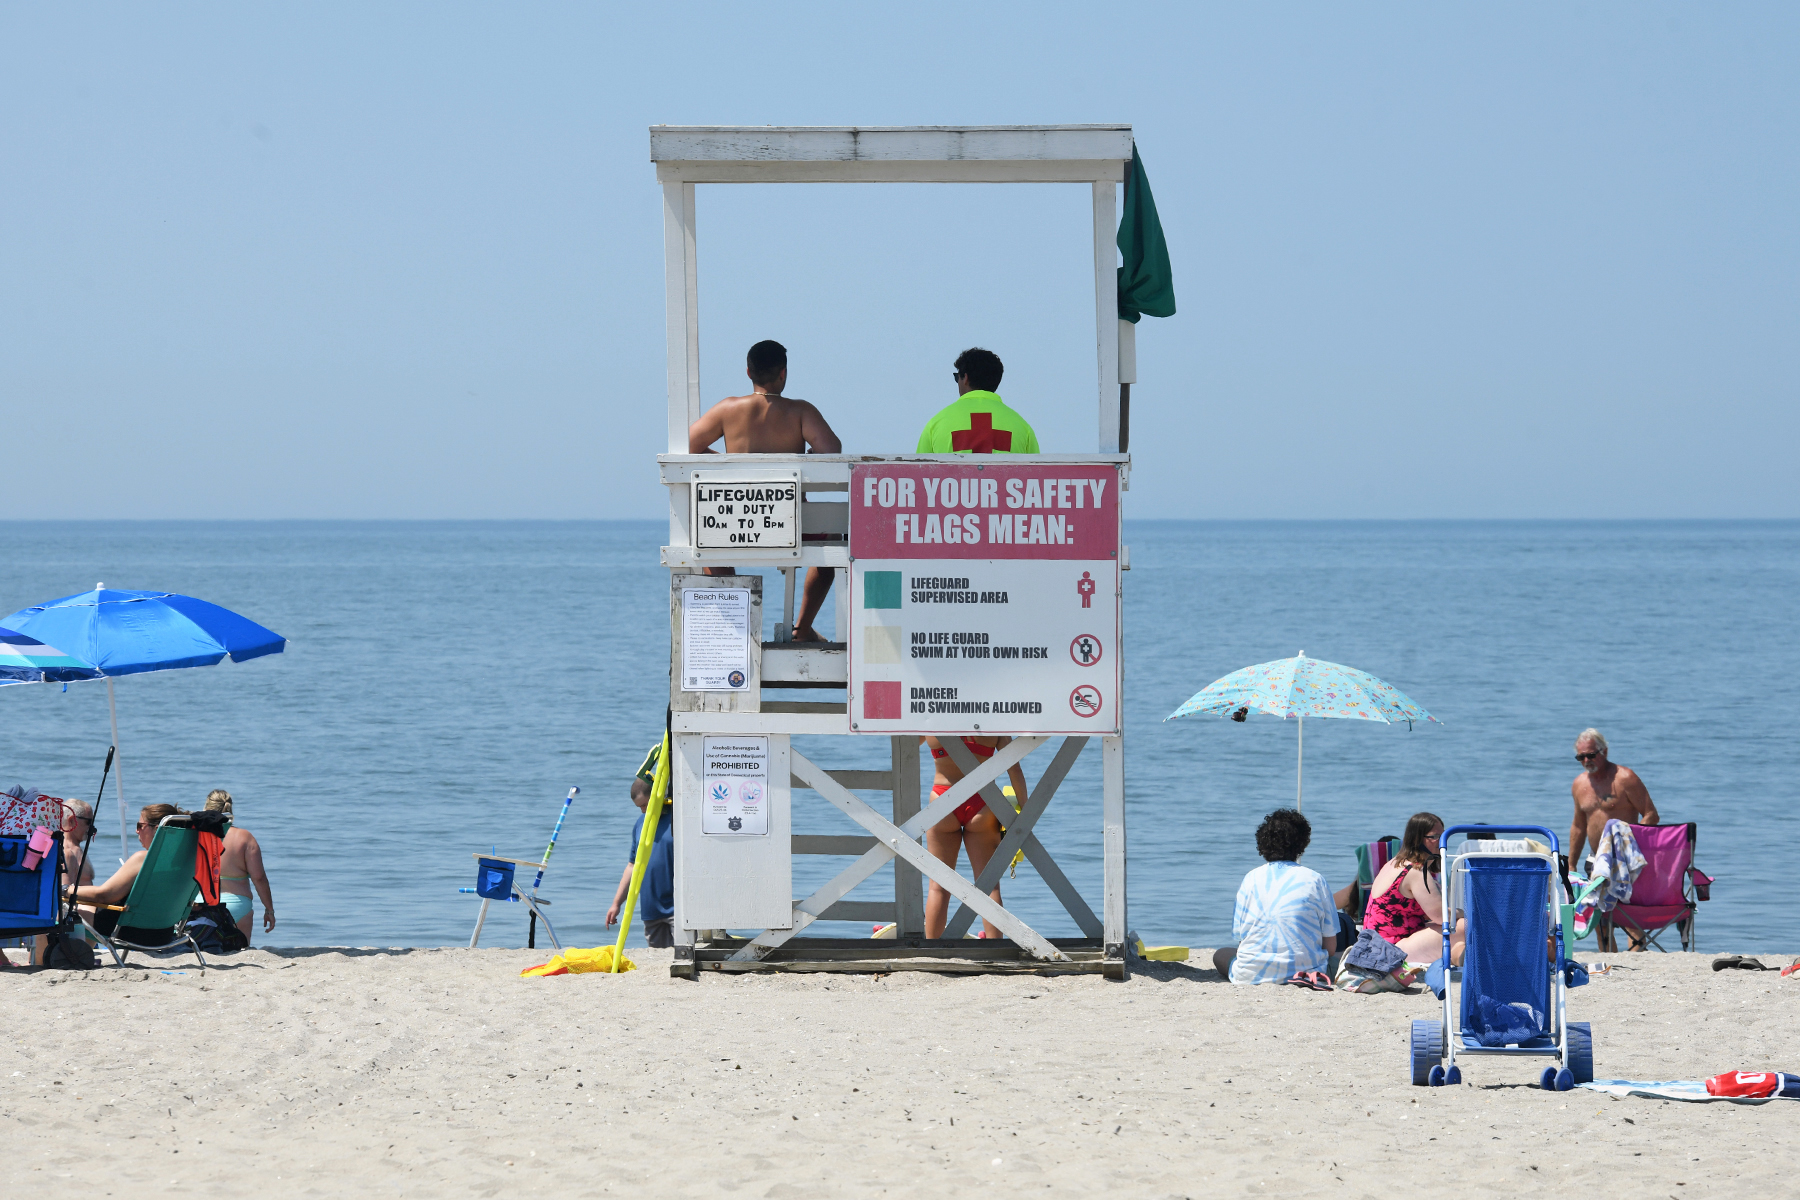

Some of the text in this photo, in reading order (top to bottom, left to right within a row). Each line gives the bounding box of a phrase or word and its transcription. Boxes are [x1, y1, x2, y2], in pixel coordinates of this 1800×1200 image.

[699, 489, 794, 501] LIFEGUARDS
[864, 478, 1106, 508] FOR YOUR SAFETY
[718, 505, 774, 514] ON DUTY
[704, 516, 784, 528] 10AM TO 6PM
[896, 514, 1074, 544] FLAGS MEAN:
[730, 533, 760, 543] ONLY
[911, 578, 969, 589] LIFEGUARD
[911, 592, 1008, 603] SUPERVISED AREA
[912, 633, 989, 644] NO LIFE GUARD
[911, 646, 1048, 659] SWIM AT YOUR OWN RISK
[911, 688, 957, 699] DANGER!
[911, 702, 1042, 714] NO SWIMMING ALLOWED
